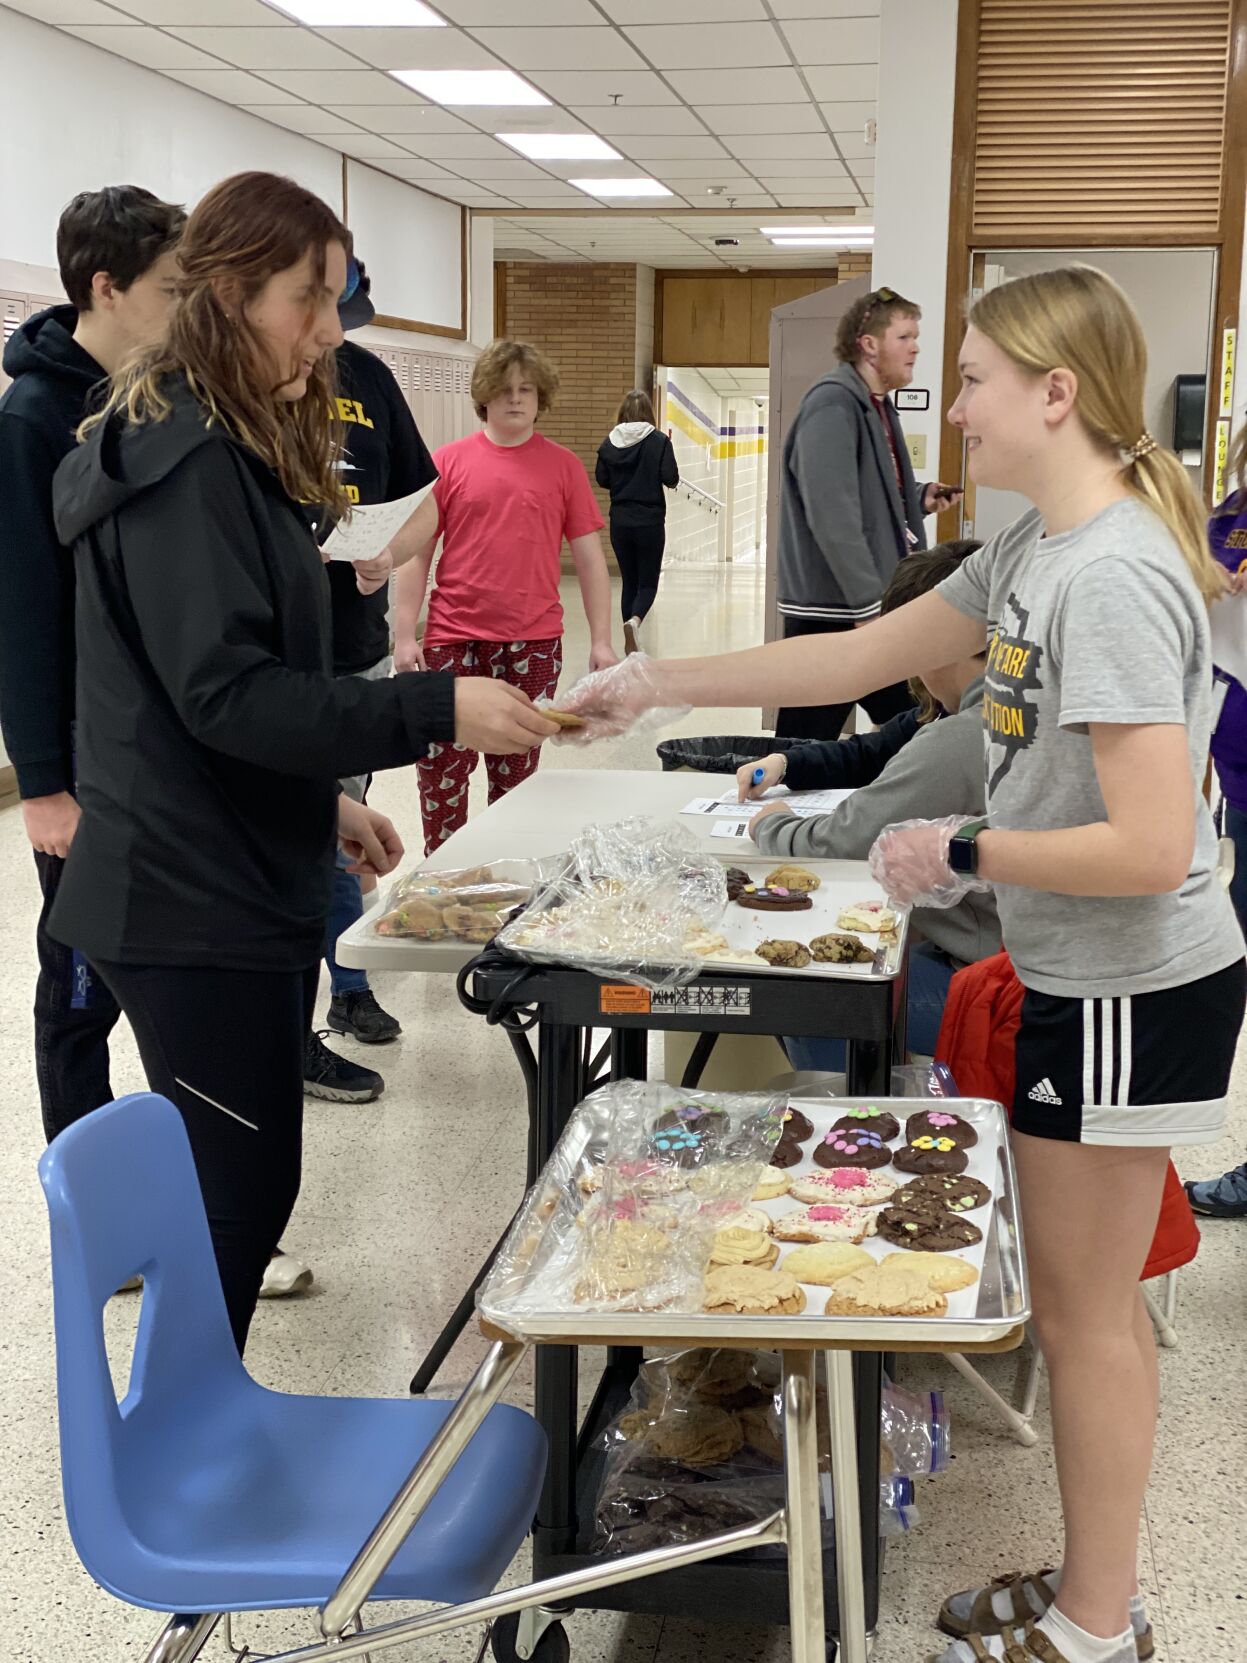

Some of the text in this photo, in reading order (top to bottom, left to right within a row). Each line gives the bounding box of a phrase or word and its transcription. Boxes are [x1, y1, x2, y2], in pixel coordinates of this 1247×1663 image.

[1223, 335, 1233, 406] STAFF
[1216, 426, 1227, 500] LOUNGE
[1028, 1091, 1062, 1105] adidas
